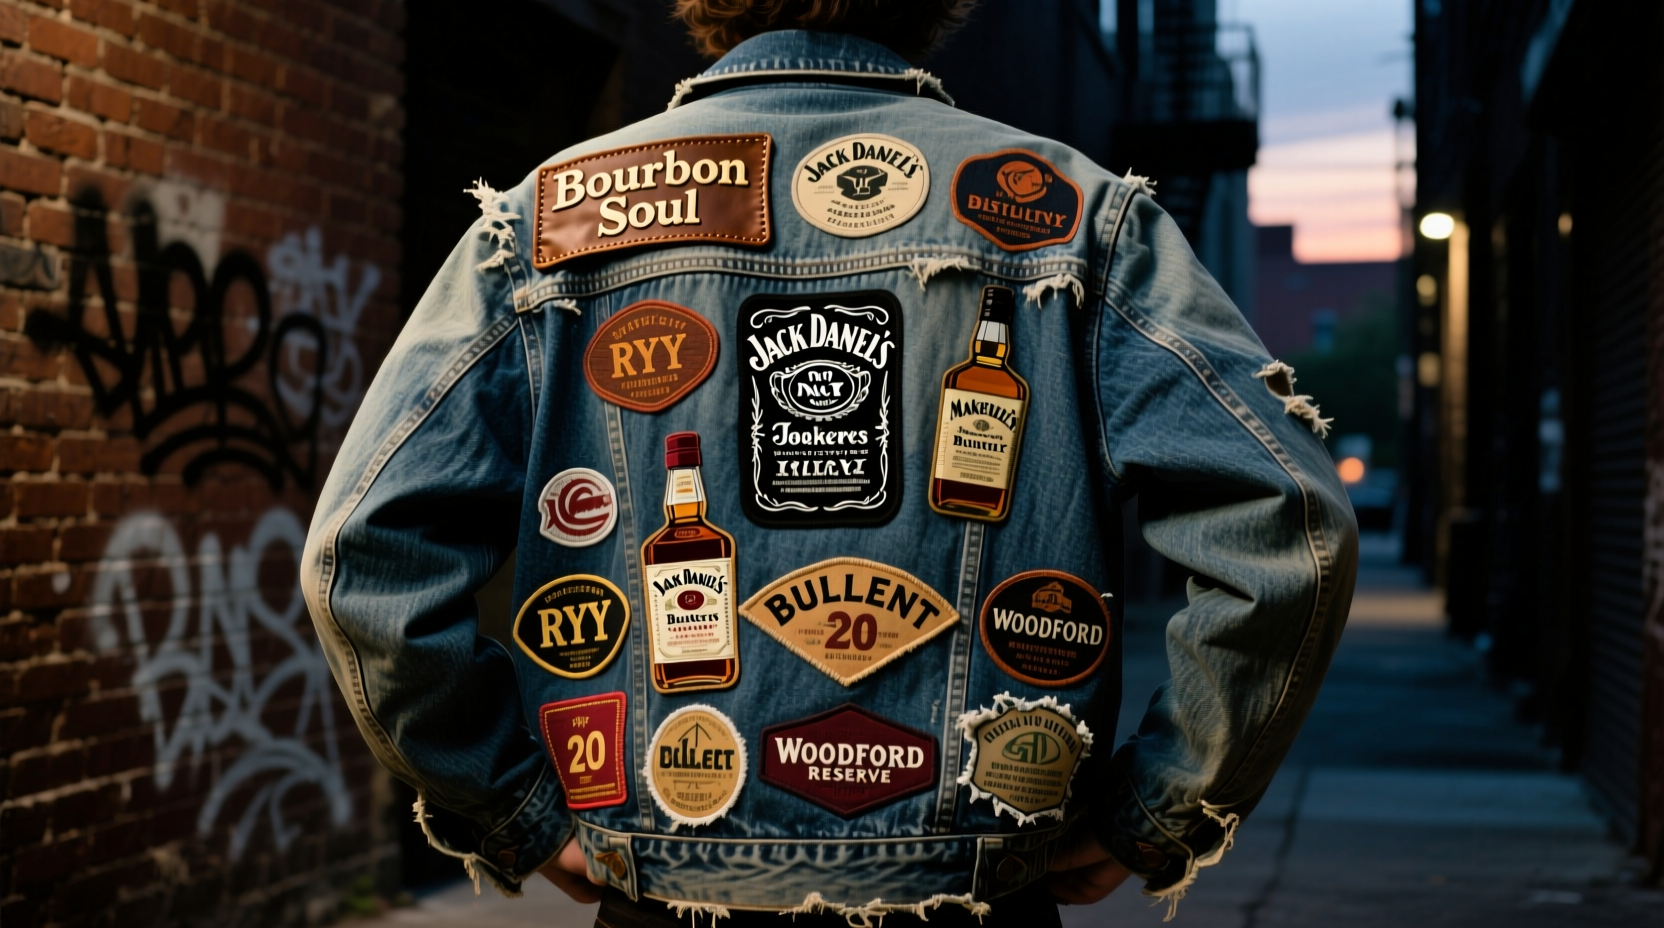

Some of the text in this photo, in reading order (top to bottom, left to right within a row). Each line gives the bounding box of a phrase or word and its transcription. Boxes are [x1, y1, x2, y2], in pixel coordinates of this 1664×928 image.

[552, 150, 748, 212] Bourbon
[804, 148, 850, 183] JACK
[597, 188, 701, 237] Soul
[609, 333, 687, 379] RYY
[747, 324, 809, 371] JACK
[537, 599, 612, 649] RYY
[764, 573, 940, 630] BULLENT
[824, 610, 878, 651] 20
[993, 607, 1103, 646] WOODFORD
[567, 730, 606, 774] 20
[775, 737, 925, 769] WOODFORD
[808, 766, 891, 784] RESERVE
